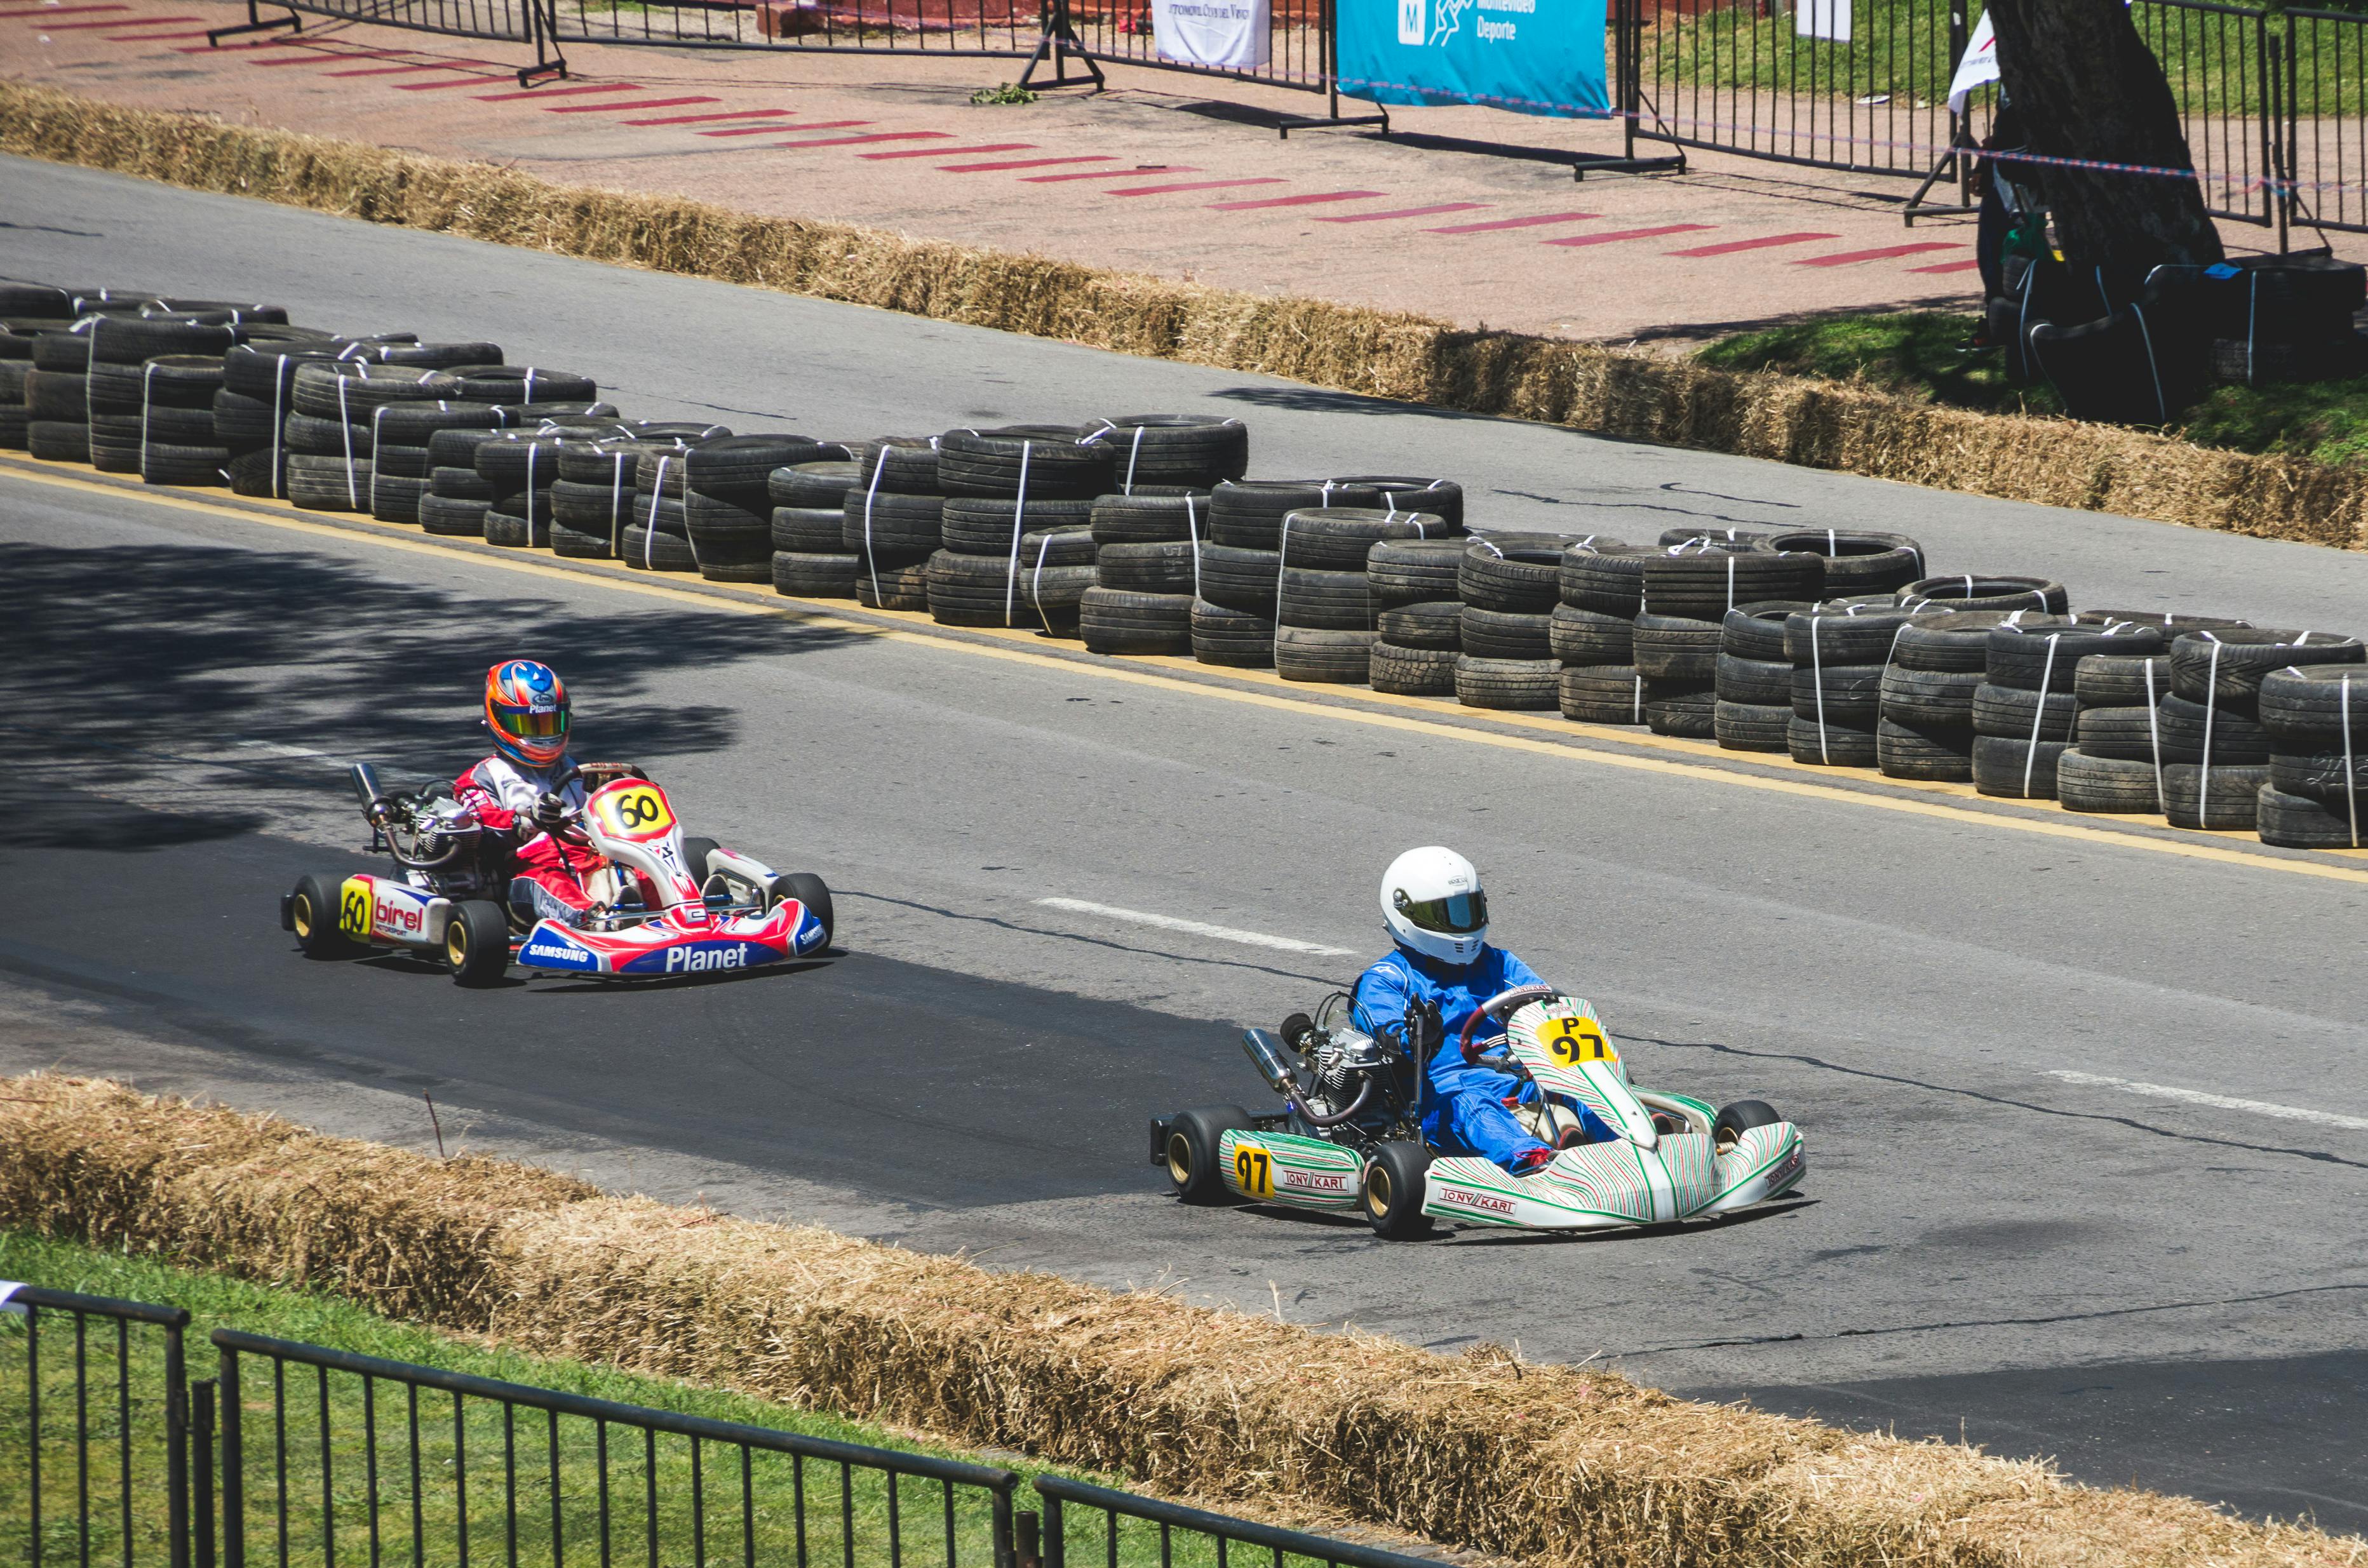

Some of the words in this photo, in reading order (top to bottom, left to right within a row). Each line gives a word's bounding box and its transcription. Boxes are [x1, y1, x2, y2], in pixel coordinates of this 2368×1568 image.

[1477, 15, 1516, 44] Deporte
[529, 704, 557, 714] Planet
[616, 794, 659, 829] 60
[343, 890, 365, 933] 60
[375, 896, 423, 933] birel
[528, 944, 589, 963] SAMSUNG
[665, 942, 748, 972] Planet
[1561, 1017, 1580, 1035] P
[1552, 1033, 1604, 1064] 97
[1237, 1151, 1268, 1194] 97
[1285, 1170, 1308, 1186] TONY
[1315, 1174, 1345, 1189] KART
[1443, 1188, 1474, 1204] TONY
[1481, 1196, 1516, 1212] KART
